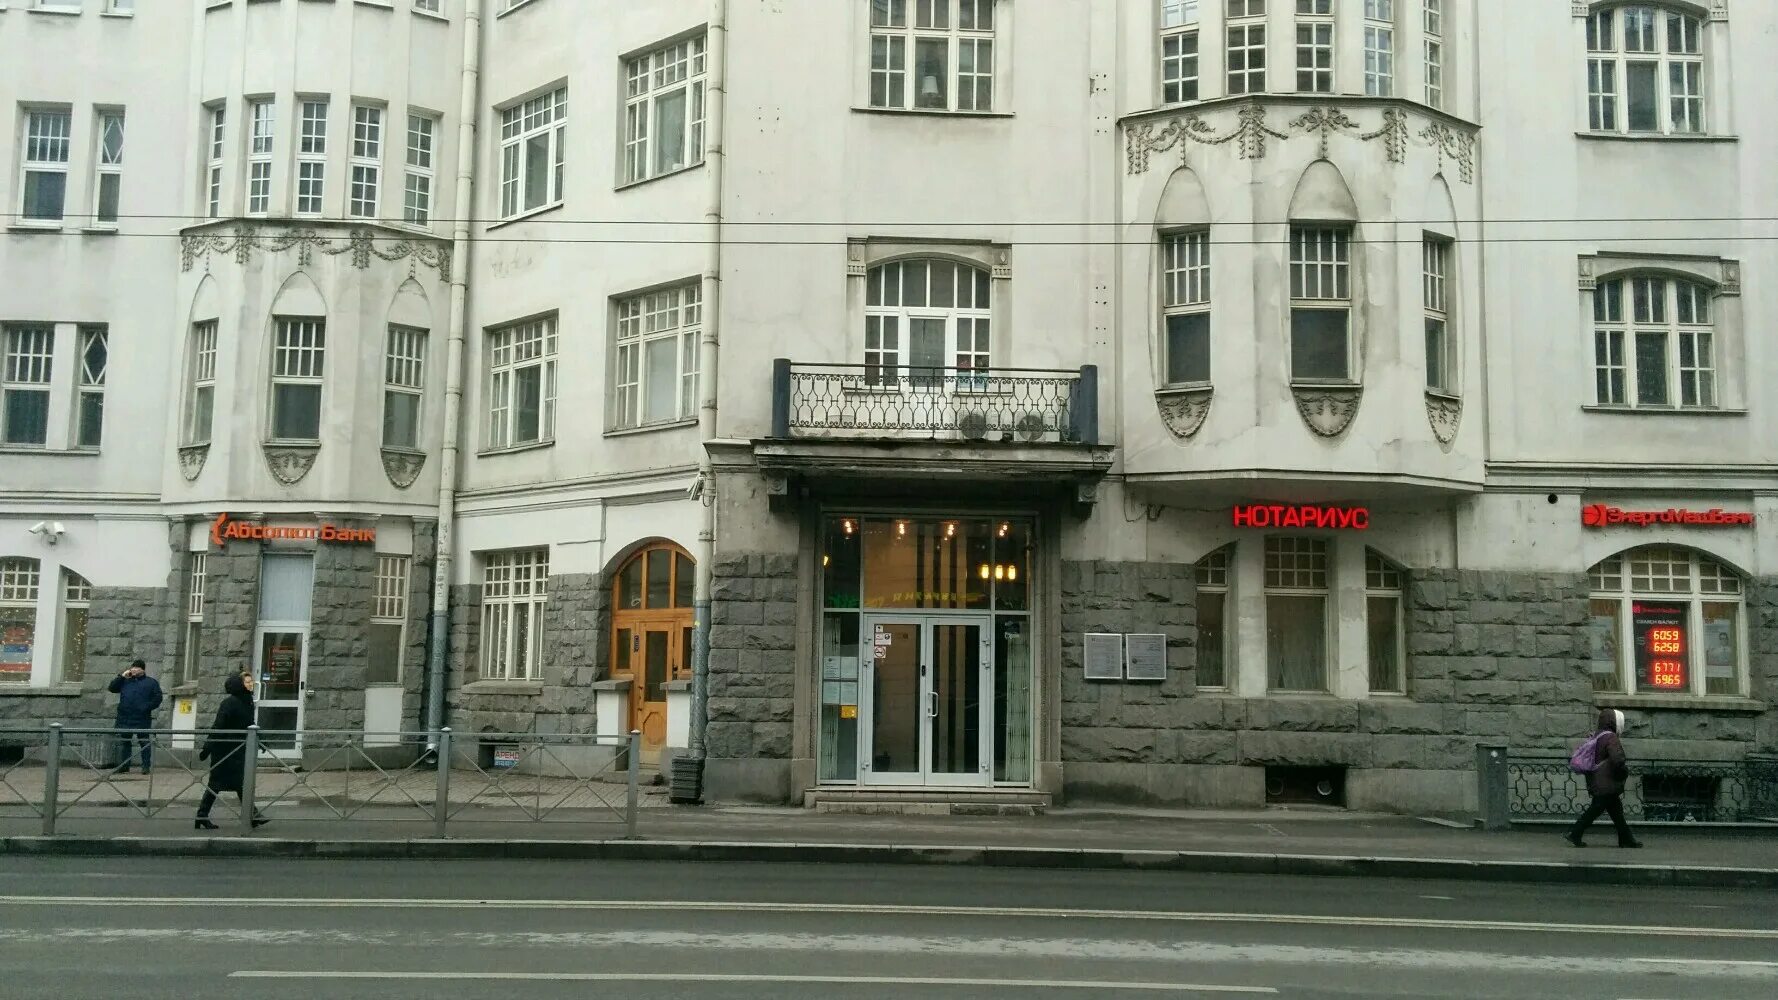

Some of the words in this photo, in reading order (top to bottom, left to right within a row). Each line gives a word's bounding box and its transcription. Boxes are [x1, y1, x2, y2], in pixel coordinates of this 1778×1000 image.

[1234, 504, 1369, 529] НОТАРИУС
[224, 521, 318, 540] Абсолют
[320, 525, 376, 541] Банк
